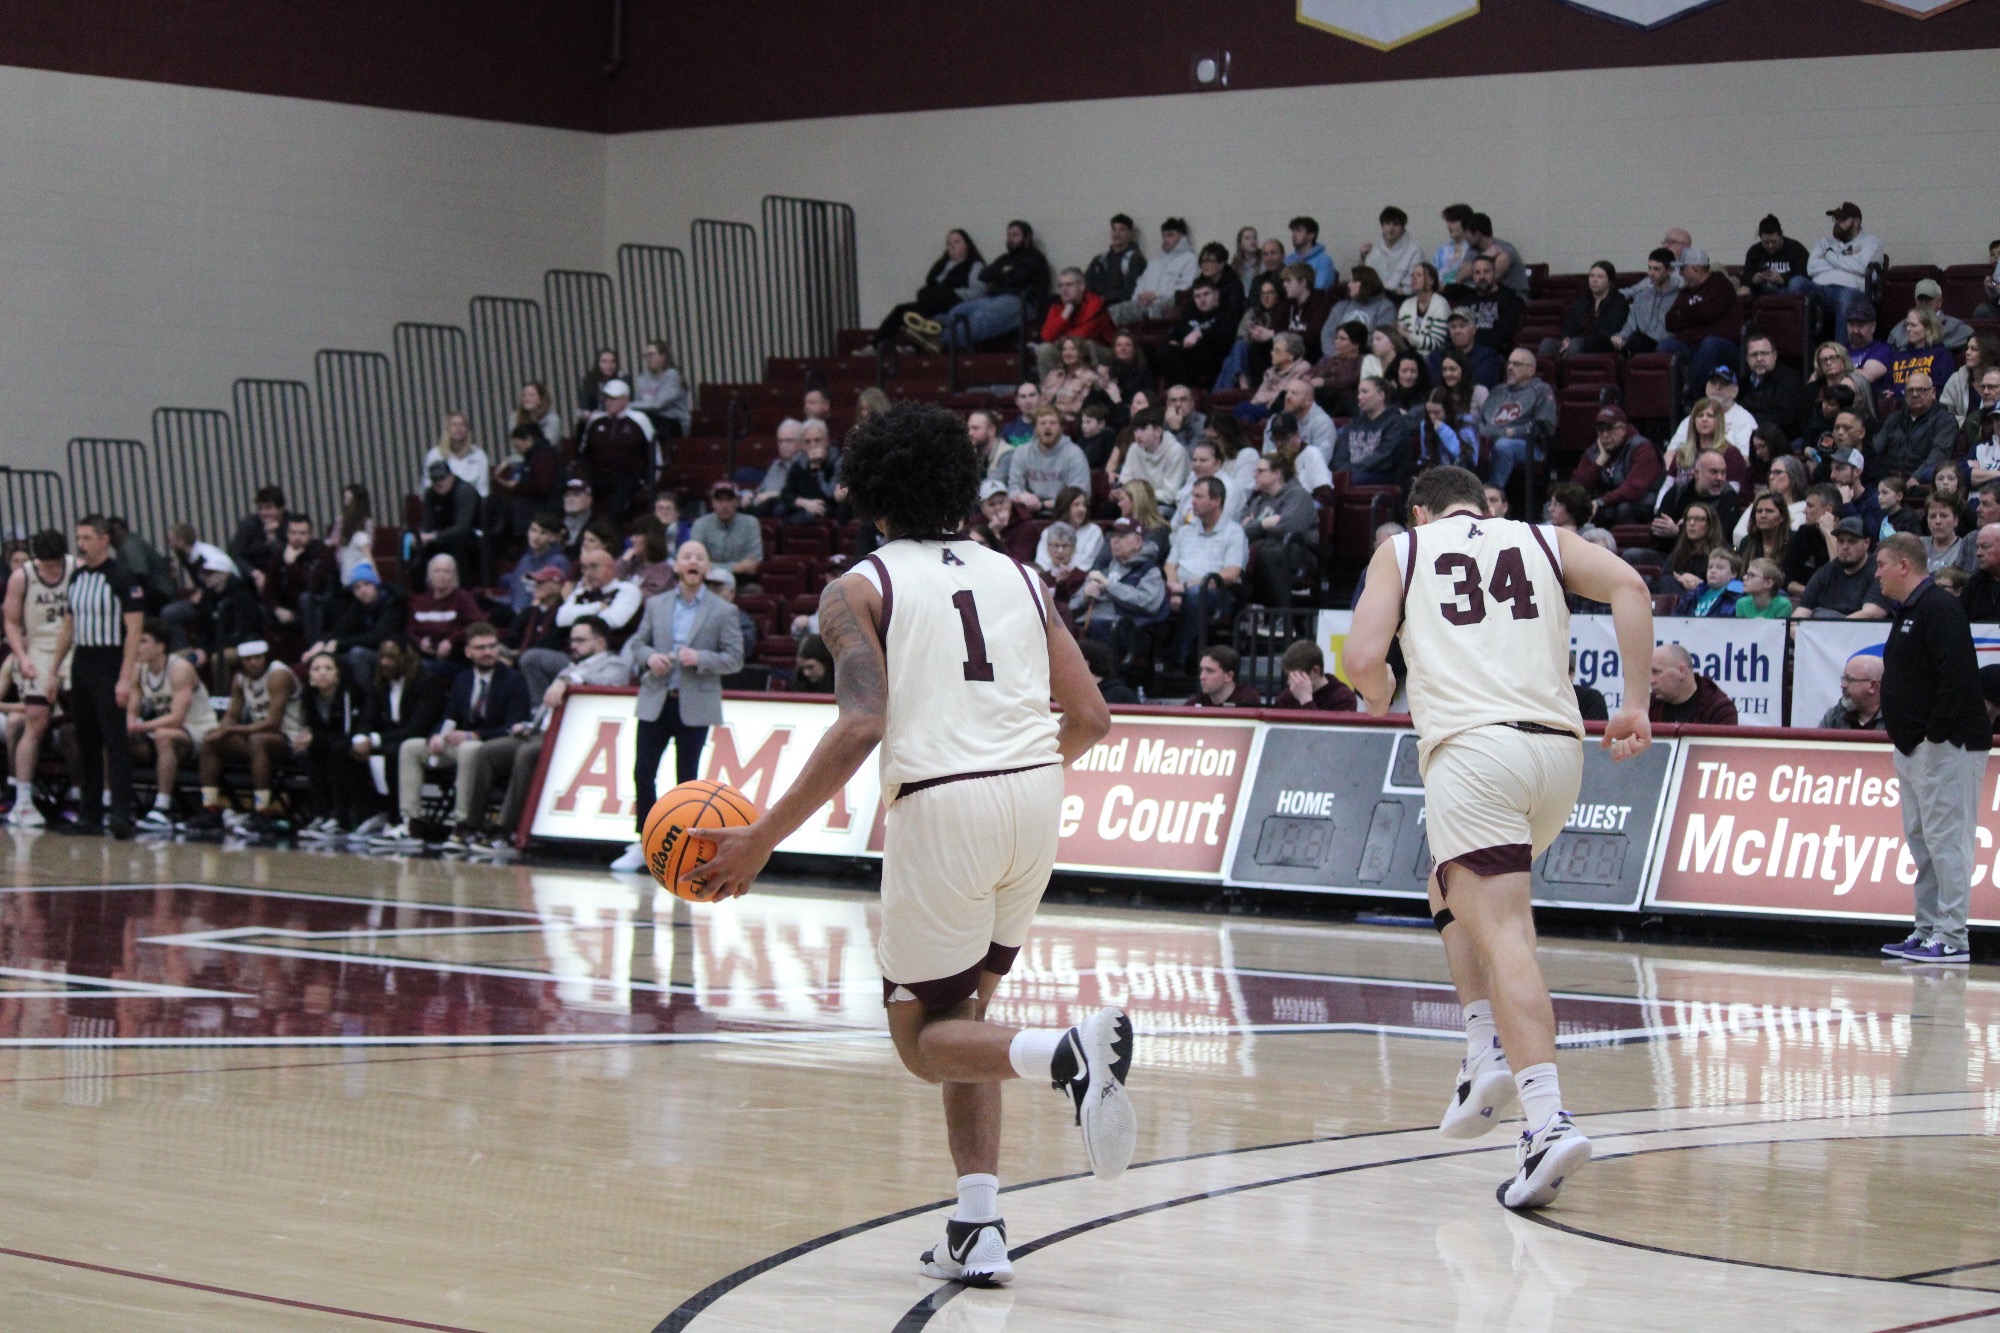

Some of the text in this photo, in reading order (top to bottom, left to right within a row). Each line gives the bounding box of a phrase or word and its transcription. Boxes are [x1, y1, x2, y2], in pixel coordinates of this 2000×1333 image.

[1434, 547, 1539, 626] 34
[952, 590, 994, 682] 1
[1655, 640, 1769, 682] alth
[1133, 738, 1237, 776] Marion
[1276, 790, 1335, 816] HOME
[1697, 762, 1900, 808] The Charles
[1097, 785, 1226, 846] Court
[1677, 812, 1919, 896] McIntyre
